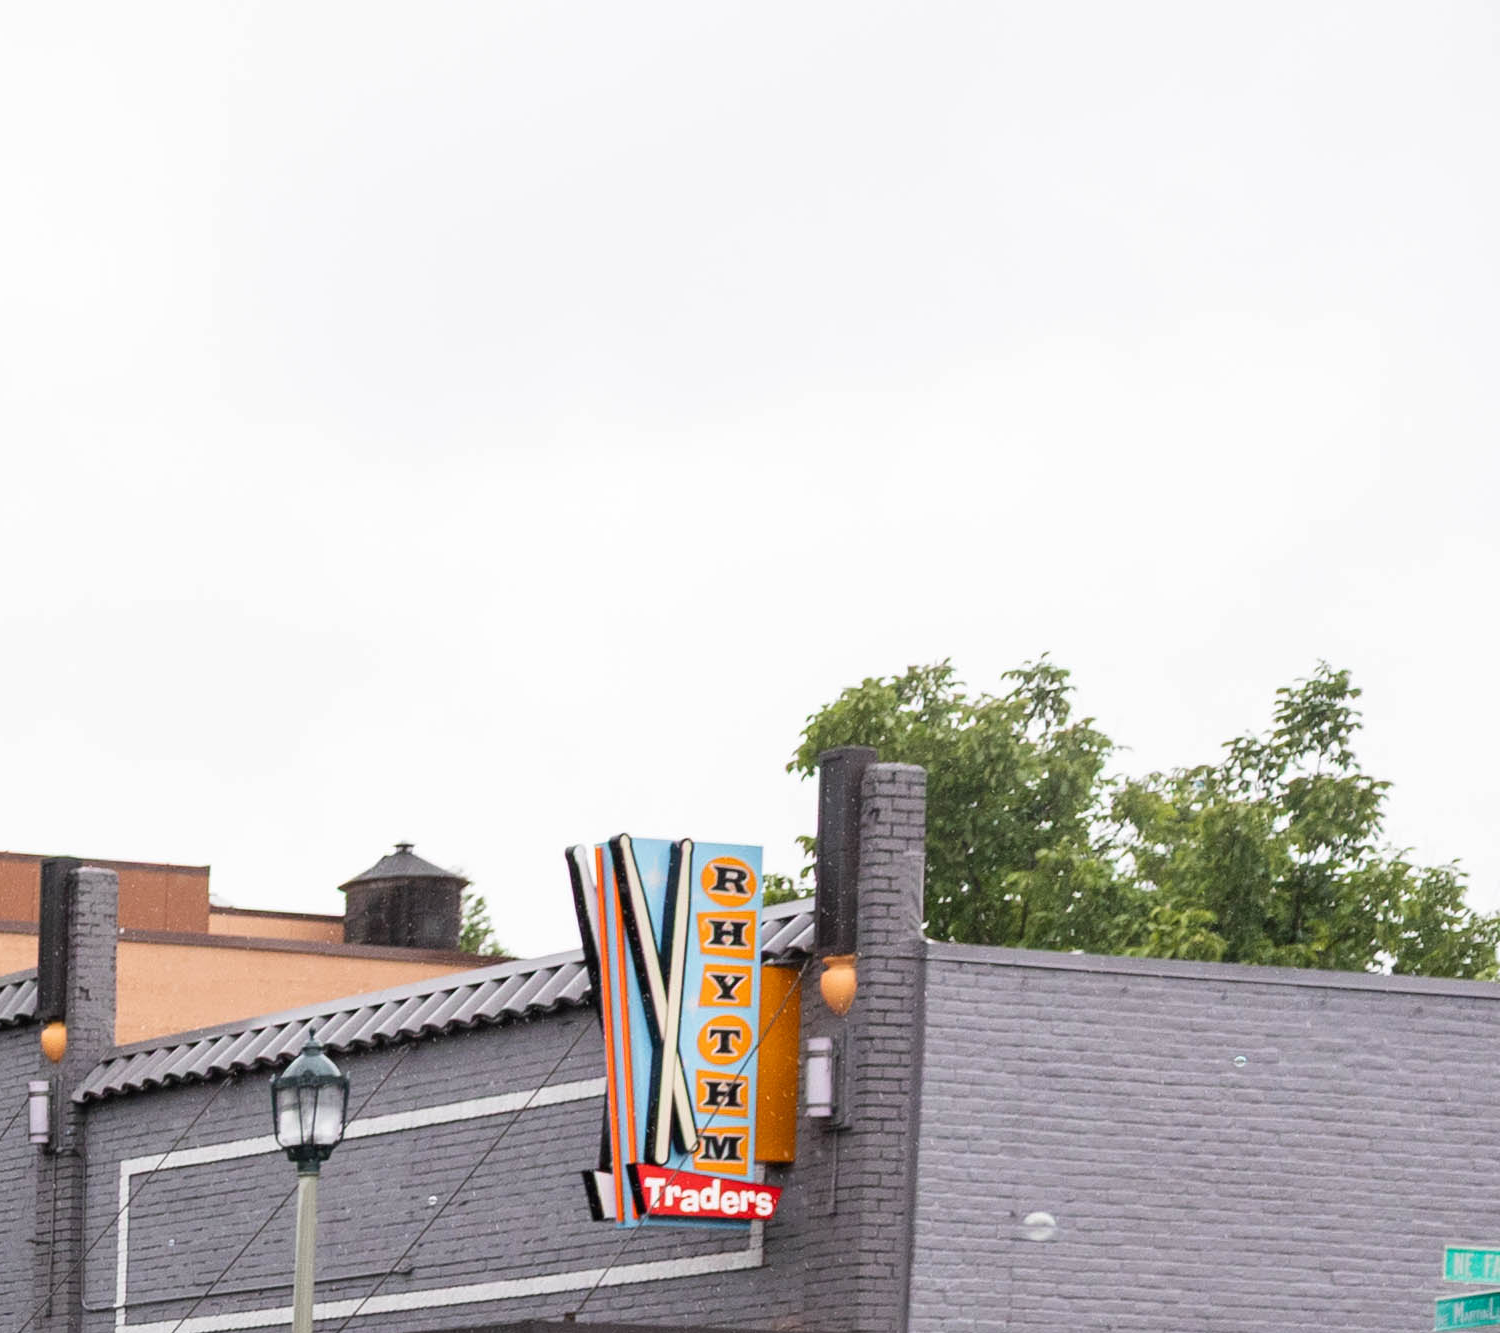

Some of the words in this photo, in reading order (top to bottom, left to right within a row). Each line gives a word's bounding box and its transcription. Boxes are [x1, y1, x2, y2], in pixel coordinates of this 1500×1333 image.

[700, 864, 750, 1162] RHYTHM
[643, 1176, 775, 1217] Traders
[1453, 1252, 1474, 1278] NE
